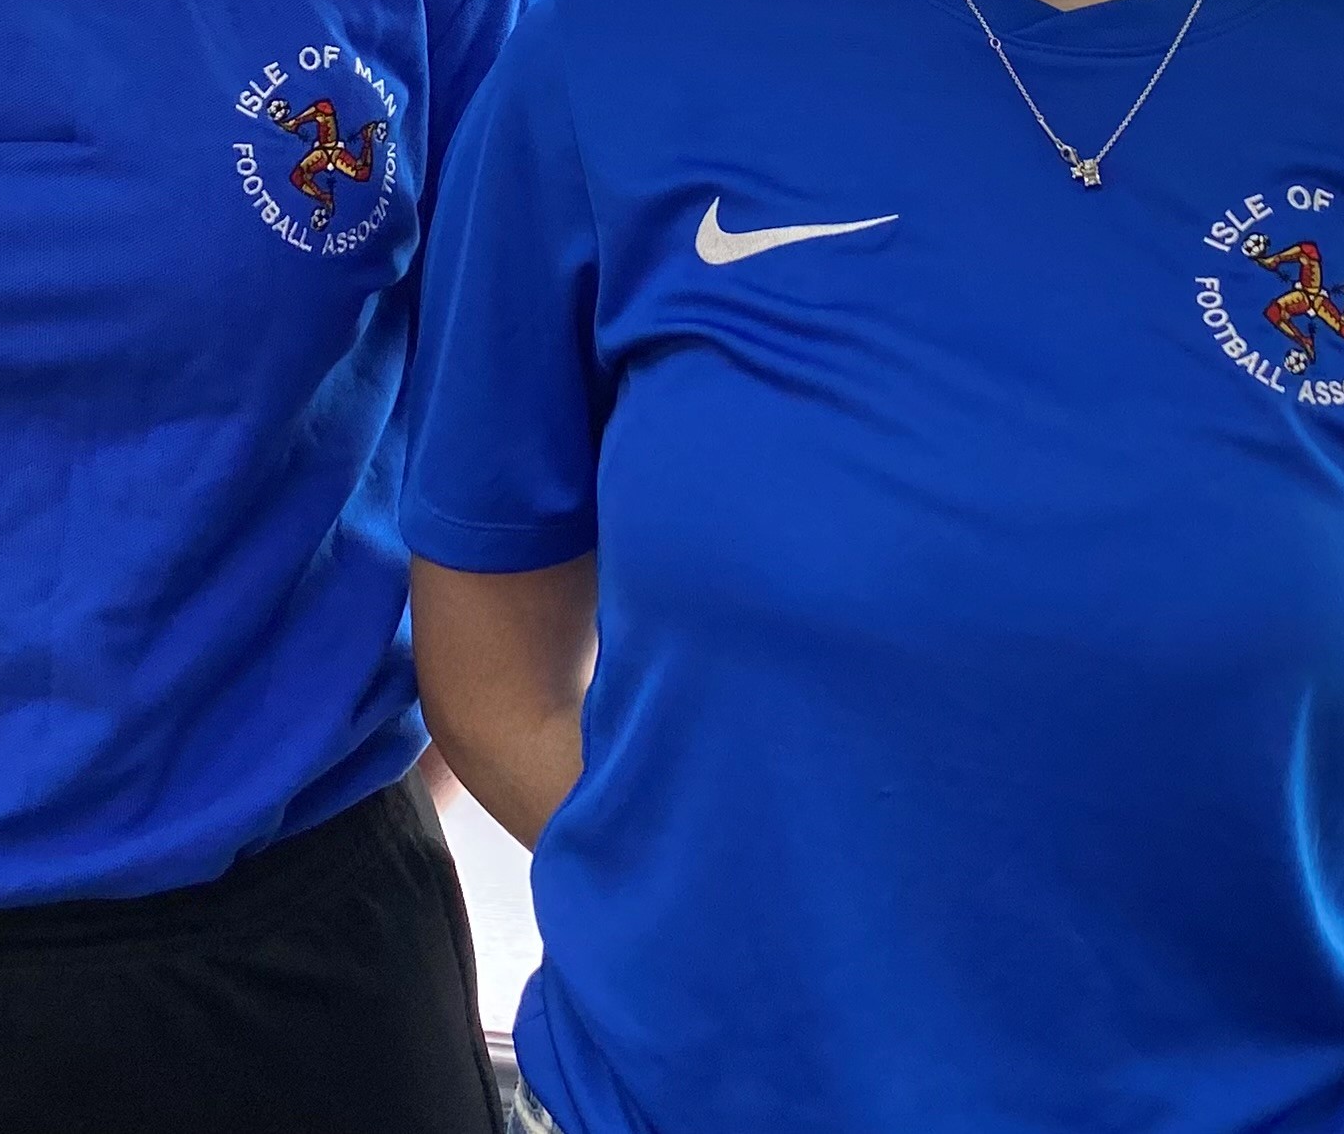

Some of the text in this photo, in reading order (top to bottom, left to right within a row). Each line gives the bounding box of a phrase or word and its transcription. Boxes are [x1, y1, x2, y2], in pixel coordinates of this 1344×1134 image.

[235, 45, 397, 118] ISLE OF MAN
[233, 142, 396, 256] FOOTBALL ASSOCIATION
[1203, 193, 1274, 252] ISLE
[1287, 185, 1334, 212] OF
[1194, 276, 1286, 394] FOOTBALL
